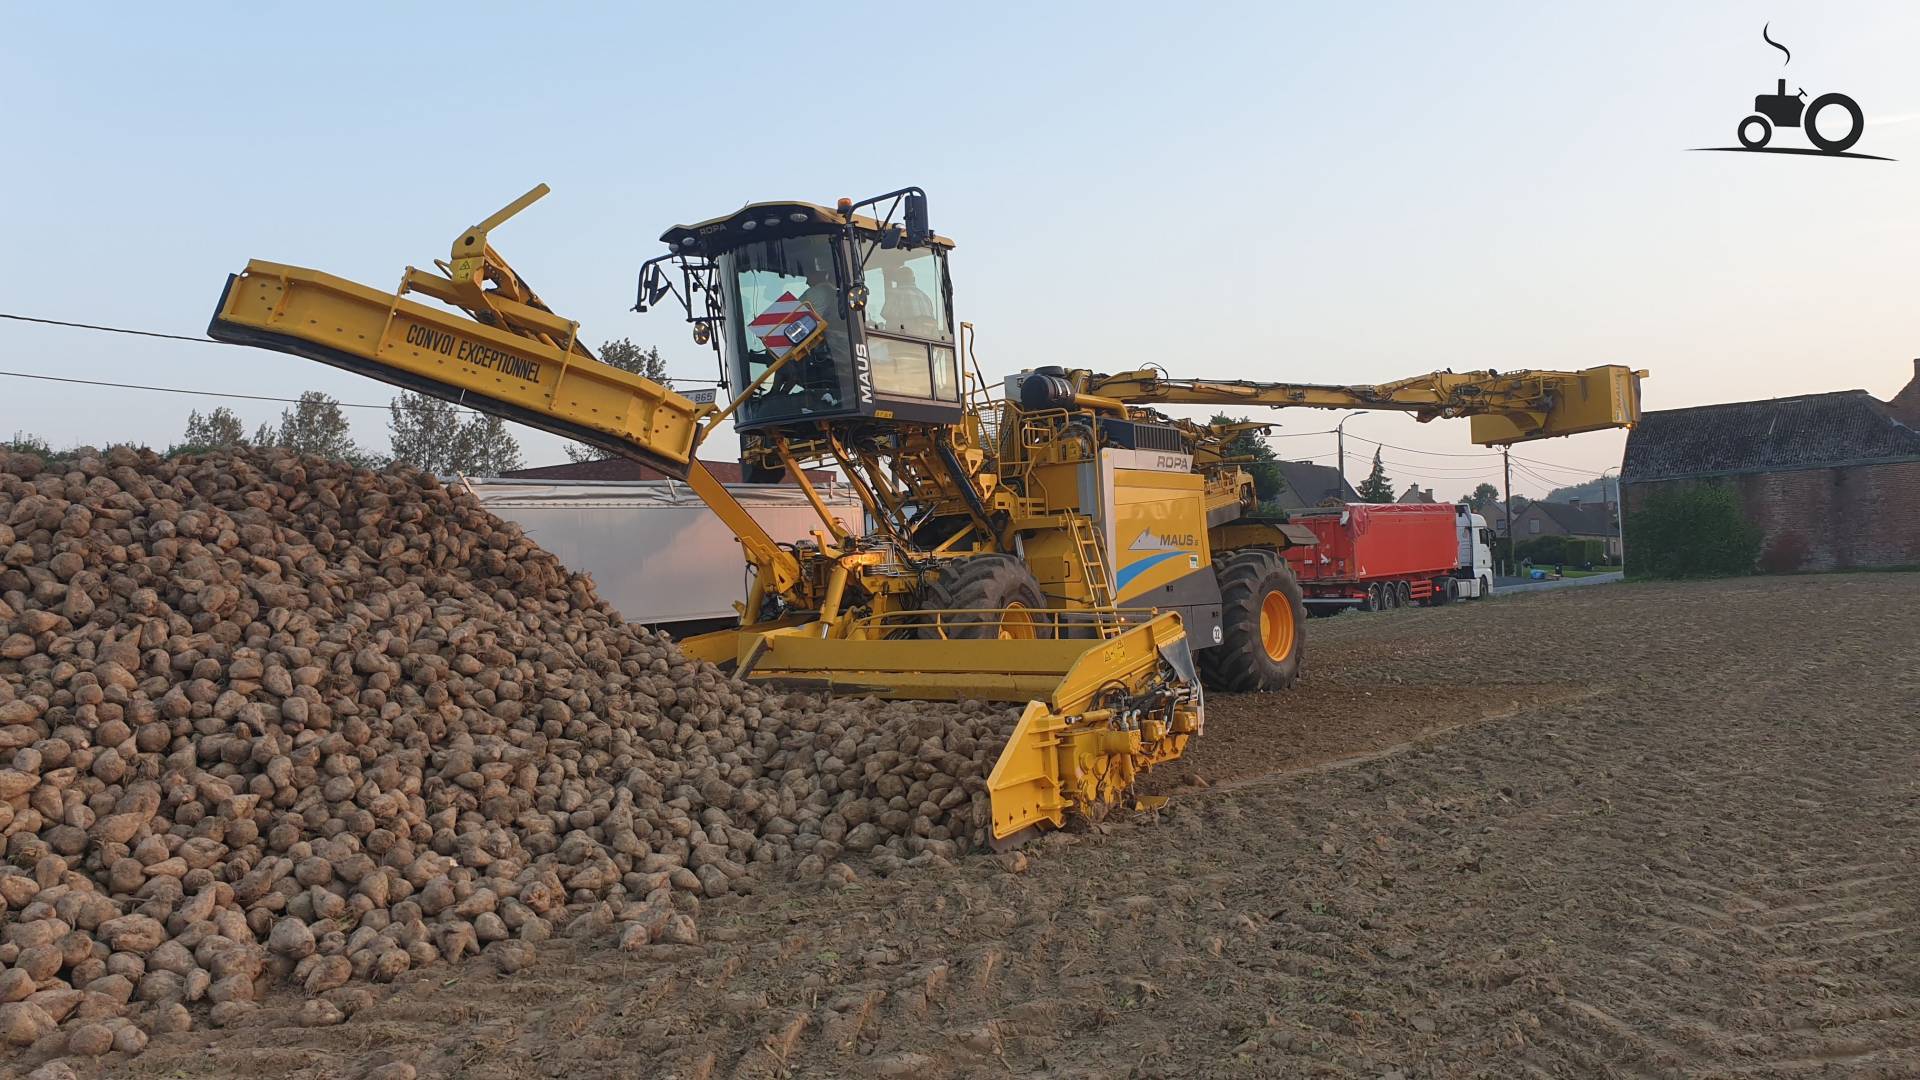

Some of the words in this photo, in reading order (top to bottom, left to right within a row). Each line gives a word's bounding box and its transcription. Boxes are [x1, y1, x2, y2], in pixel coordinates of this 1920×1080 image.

[699, 224, 727, 236] ROPA
[406, 324, 456, 357] CONVOI
[456, 340, 541, 384] EXCEPTIONNEL
[855, 343, 873, 404] MAUS
[1156, 455, 1188, 470] ROPA
[1160, 534, 1194, 546] MAUS
